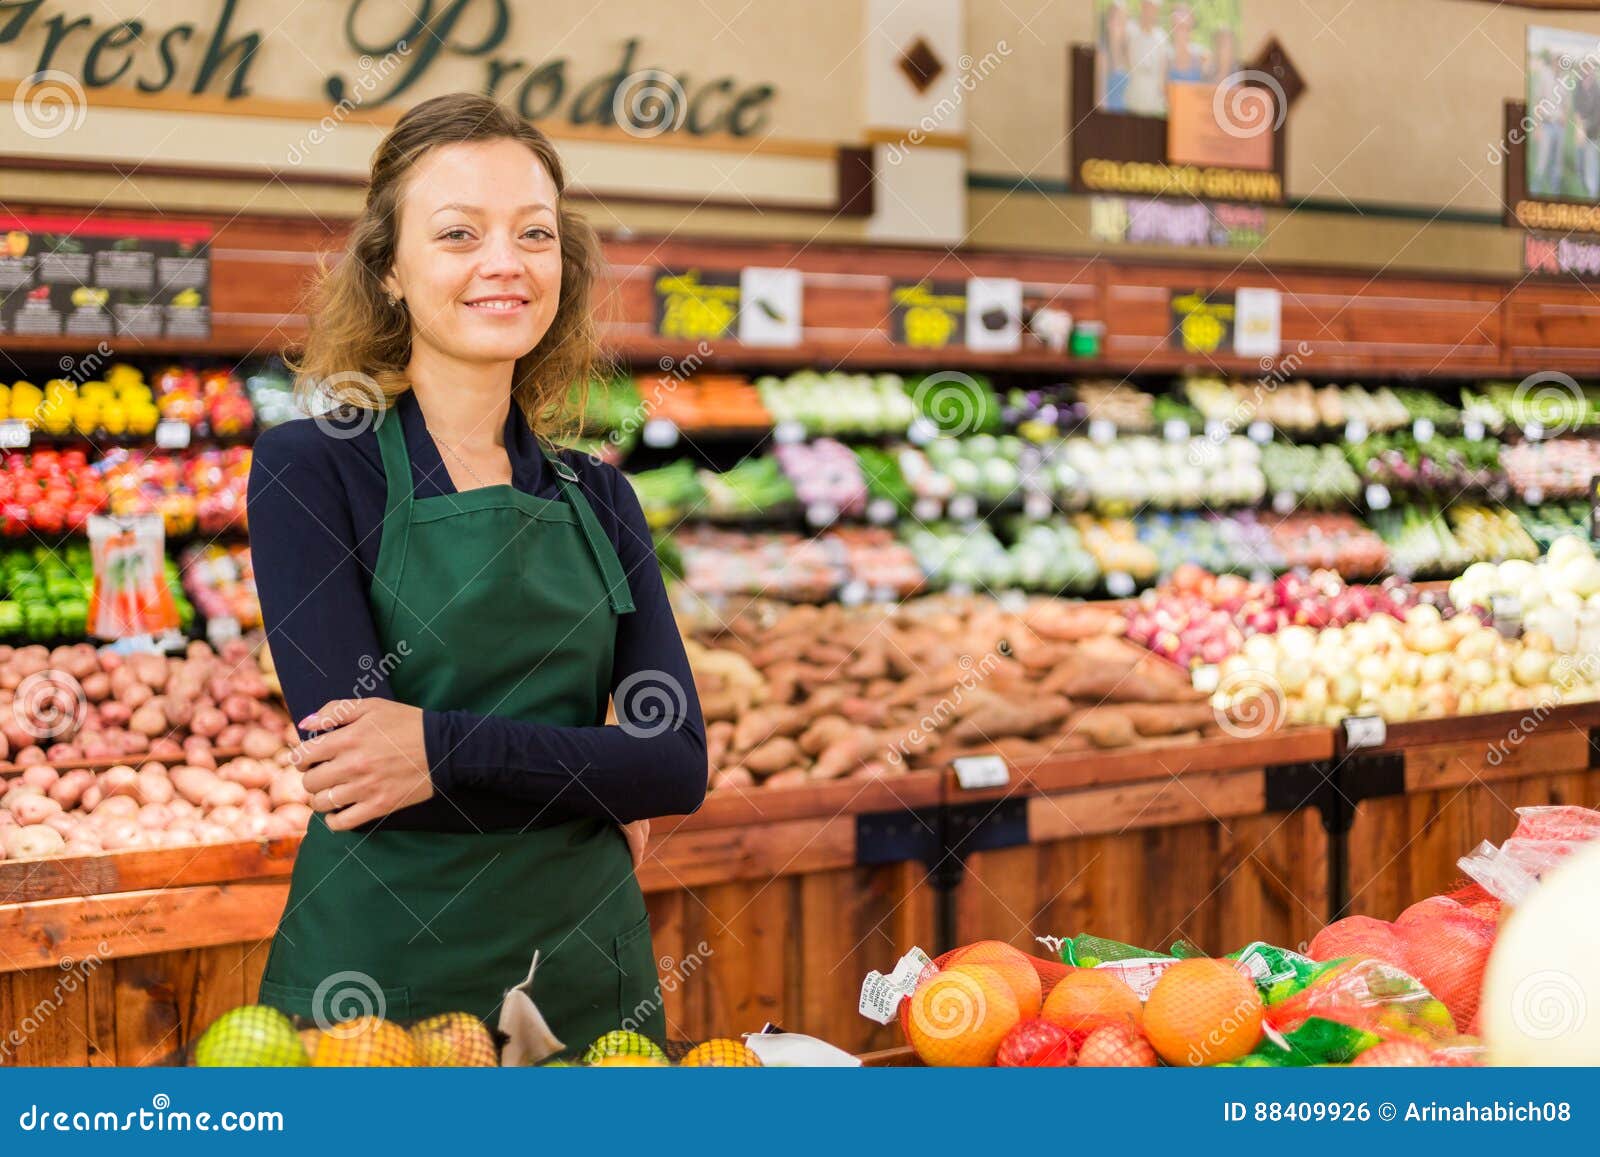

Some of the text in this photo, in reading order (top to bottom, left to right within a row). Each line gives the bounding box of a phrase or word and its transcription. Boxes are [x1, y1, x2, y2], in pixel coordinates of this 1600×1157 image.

[322, 0, 777, 139] Produce
[1080, 158, 1282, 201] COLORADO GROWN
